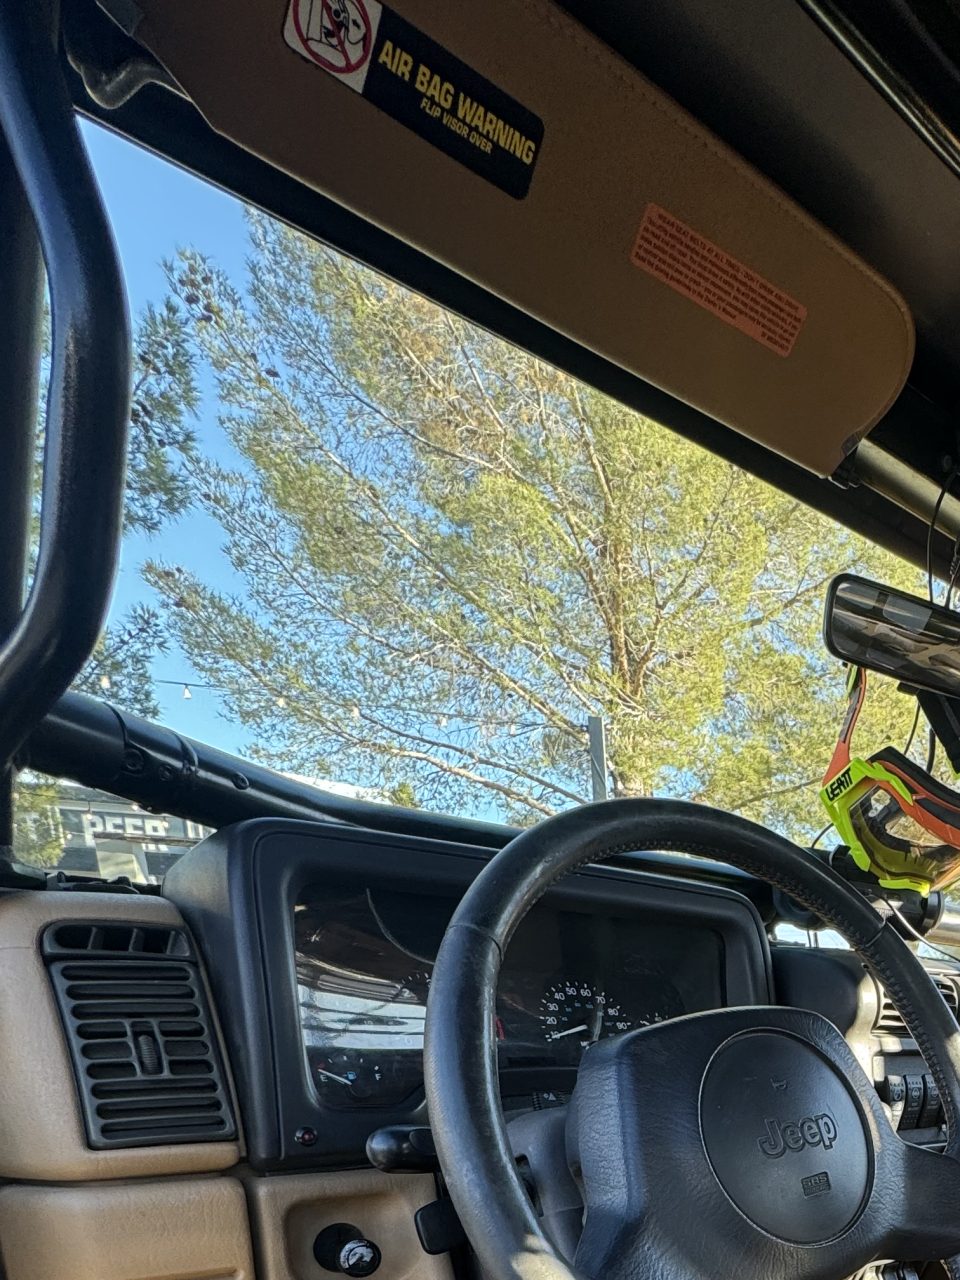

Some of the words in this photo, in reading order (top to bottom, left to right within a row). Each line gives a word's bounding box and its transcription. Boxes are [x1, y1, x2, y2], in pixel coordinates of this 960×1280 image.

[378, 39, 414, 82] AIR
[415, 63, 455, 110] BAG
[457, 91, 536, 166] WARNING
[420, 99, 442, 121] FLIP
[442, 111, 470, 139] VISOR
[469, 131, 494, 155] OVER
[825, 766, 853, 801] LEATT
[565, 987, 577, 996] 50
[580, 989, 592, 998] 60
[554, 992, 566, 1001] 40
[595, 996, 606, 1005] 70
[546, 1003, 559, 1012] 30
[607, 1008, 619, 1016] 80
[545, 1016, 558, 1025] 20
[616, 1022, 628, 1031] 90
[319, 1074, 328, 1083] E
[374, 1073, 382, 1081] F
[757, 1113, 838, 1159] Jeep
